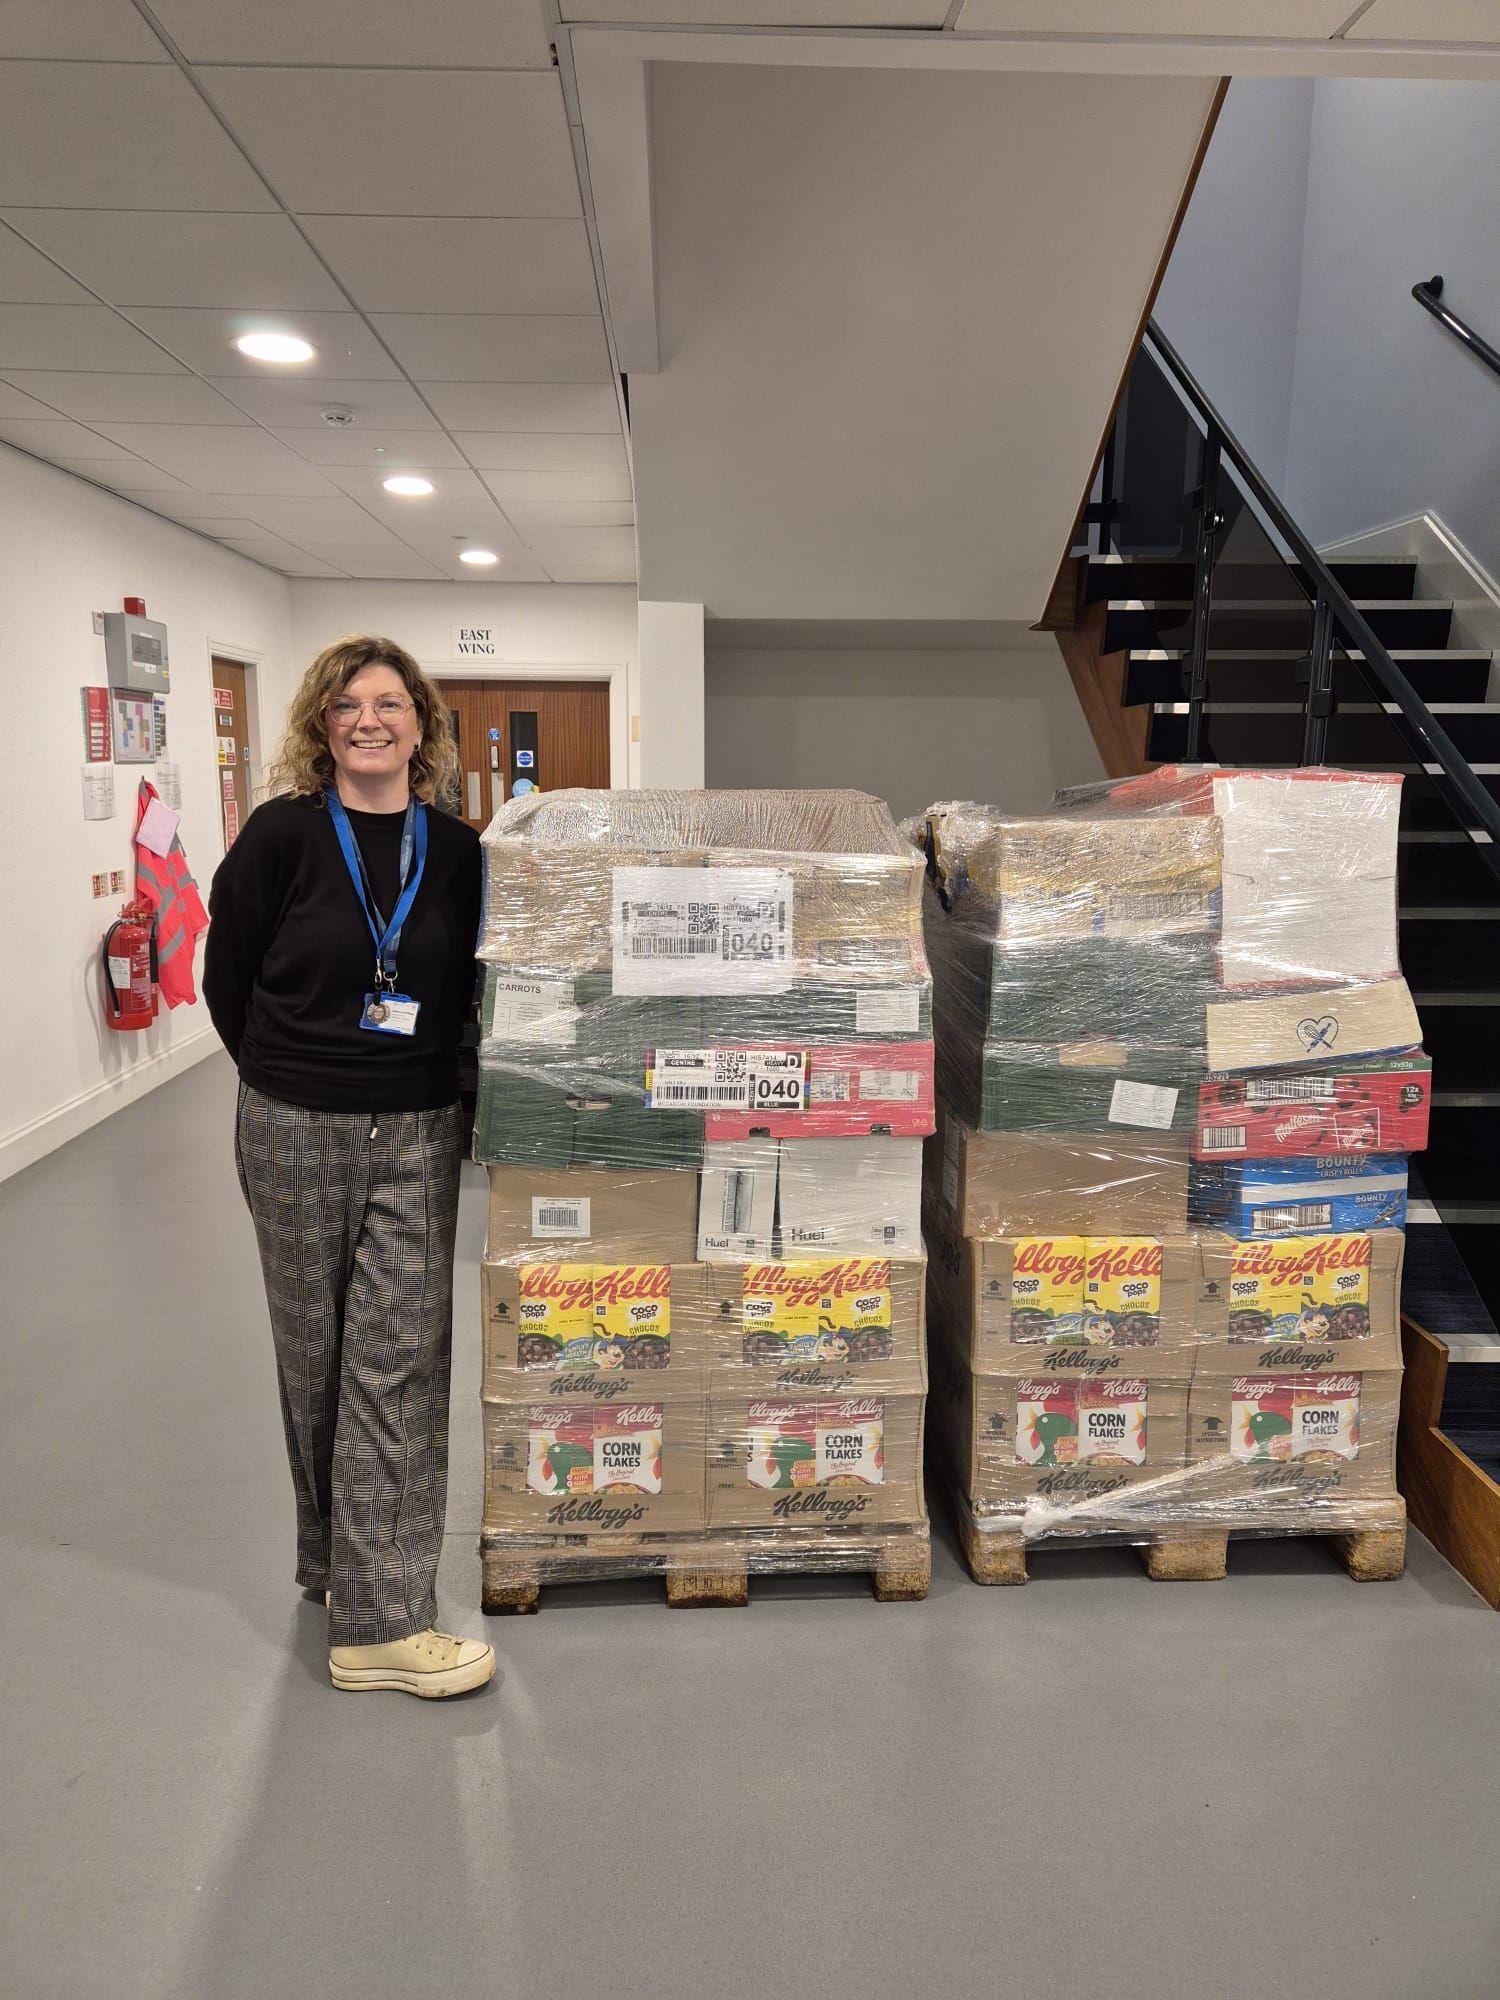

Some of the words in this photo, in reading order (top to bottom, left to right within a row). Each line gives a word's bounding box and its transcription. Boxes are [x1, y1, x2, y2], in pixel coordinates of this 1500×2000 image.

[460, 629, 491, 640] EAST
[458, 643, 494, 654] WING
[498, 983, 541, 994] CARROTS
[787, 1054, 799, 1068] D
[758, 1079, 800, 1099] 040
[1317, 1155, 1366, 1169] BOUNTY
[1320, 1168, 1343, 1178] CRISPY
[1343, 1167, 1363, 1175] ROLLS
[1355, 1193, 1388, 1203] BOUNTY
[791, 1227, 826, 1241] Huel
[705, 1237, 729, 1247] Huel
[1017, 1285, 1038, 1295] pops
[1341, 1280, 1359, 1291] pops
[1126, 1288, 1147, 1298] pops
[1237, 1287, 1257, 1297] pops
[1335, 1292, 1361, 1304] CHOCOS
[860, 1303, 880, 1314] pops
[1120, 1301, 1150, 1311] CHOCOS
[525, 1311, 545, 1319] pops
[636, 1312, 657, 1321] pops
[854, 1315, 883, 1326] CHOCOS
[629, 1324, 660, 1335] CHOCOS
[1043, 1348, 1121, 1375] Kellogg's
[1259, 1346, 1337, 1371] Kellogg's
[549, 1373, 631, 1399] Kellogg's
[1088, 1413, 1126, 1428] CORN
[1302, 1410, 1339, 1425] CORN
[1089, 1427, 1126, 1439] FLAKES
[1302, 1424, 1339, 1436] FLAKES
[825, 1435, 863, 1449] CORN
[602, 1442, 641, 1457] CORN
[825, 1449, 863, 1460] FLAKES
[603, 1456, 641, 1468] FLAKES
[1036, 1467, 1131, 1500] Kellogg's
[1253, 1467, 1344, 1495] Kellogg's
[773, 1490, 869, 1521] Kellogg's
[548, 1498, 646, 1530] Kellogg's
